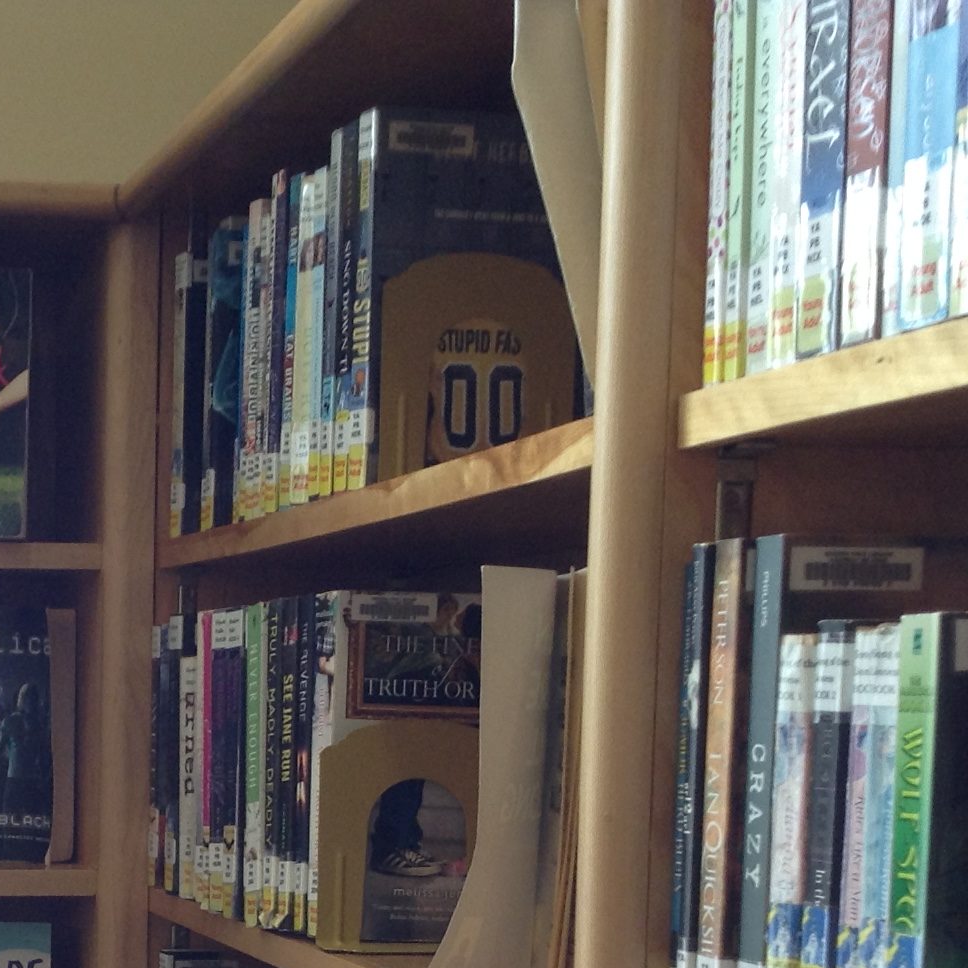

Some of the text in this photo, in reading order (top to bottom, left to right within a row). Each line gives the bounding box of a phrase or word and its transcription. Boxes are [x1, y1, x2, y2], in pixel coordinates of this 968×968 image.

[754, 38, 772, 209] everywhere
[339, 239, 352, 351] SING DOWN
[352, 298, 371, 364] STUPI
[437, 329, 491, 356] STUPID
[364, 677, 475, 699] TRUTH OR
[384, 634, 424, 655] THE
[706, 578, 731, 815] PETERSON IAN
[246, 643, 260, 790] NEVER ENOUGH
[280, 673, 294, 782] SEE JANE RUN
[745, 570, 770, 889] PHILLIPS CRAZY
[898, 728, 923, 835] WOLF
